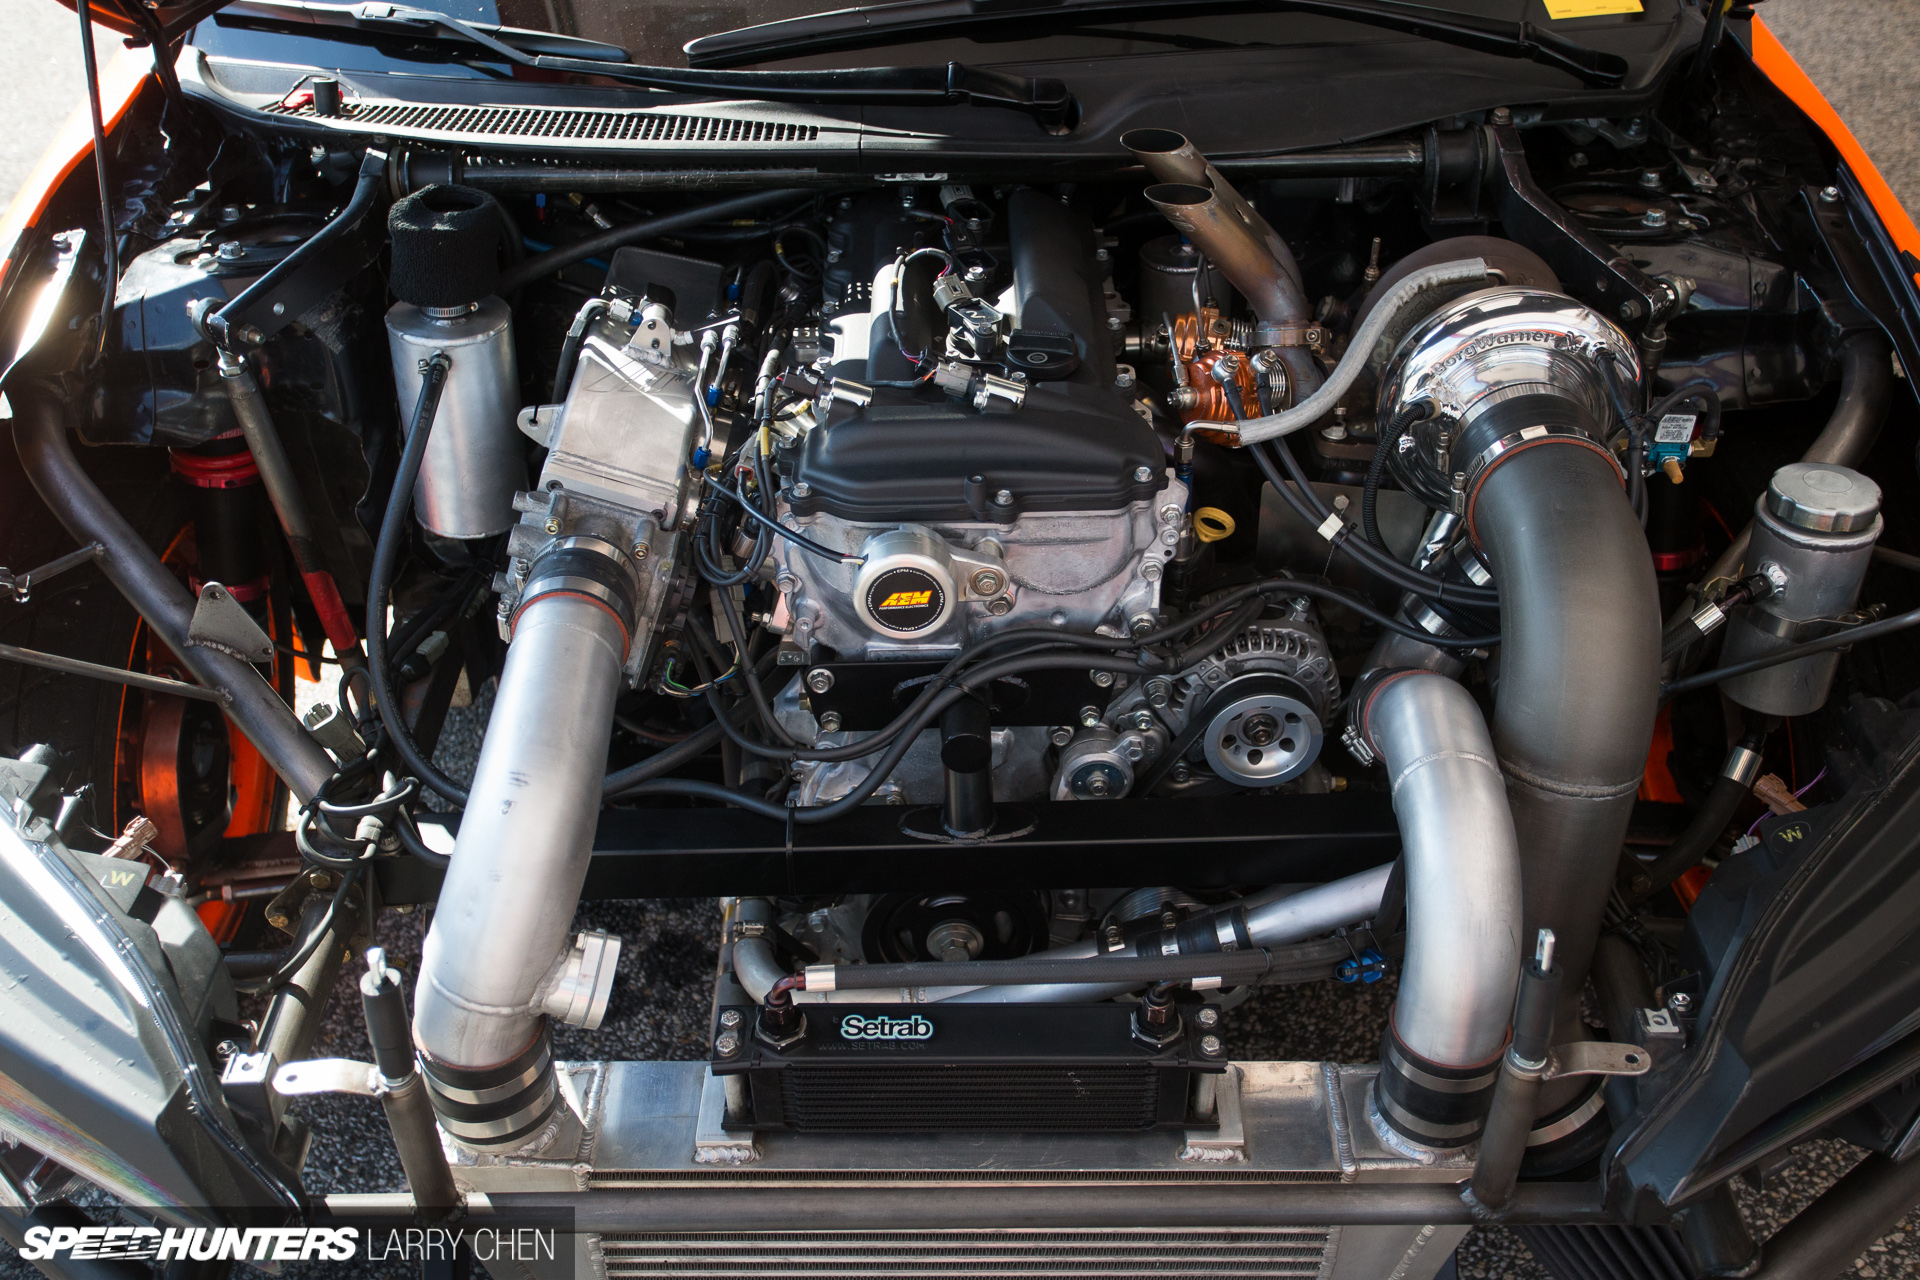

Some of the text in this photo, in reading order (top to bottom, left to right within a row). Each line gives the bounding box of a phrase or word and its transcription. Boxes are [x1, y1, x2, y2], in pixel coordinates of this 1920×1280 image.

[1430, 331, 1555, 376] BorgWarner
[879, 590, 933, 607] AEM
[111, 870, 136, 887] W
[841, 1014, 934, 1039] Setrab
[818, 1041, 925, 1050] WWW.SETRAB.COM
